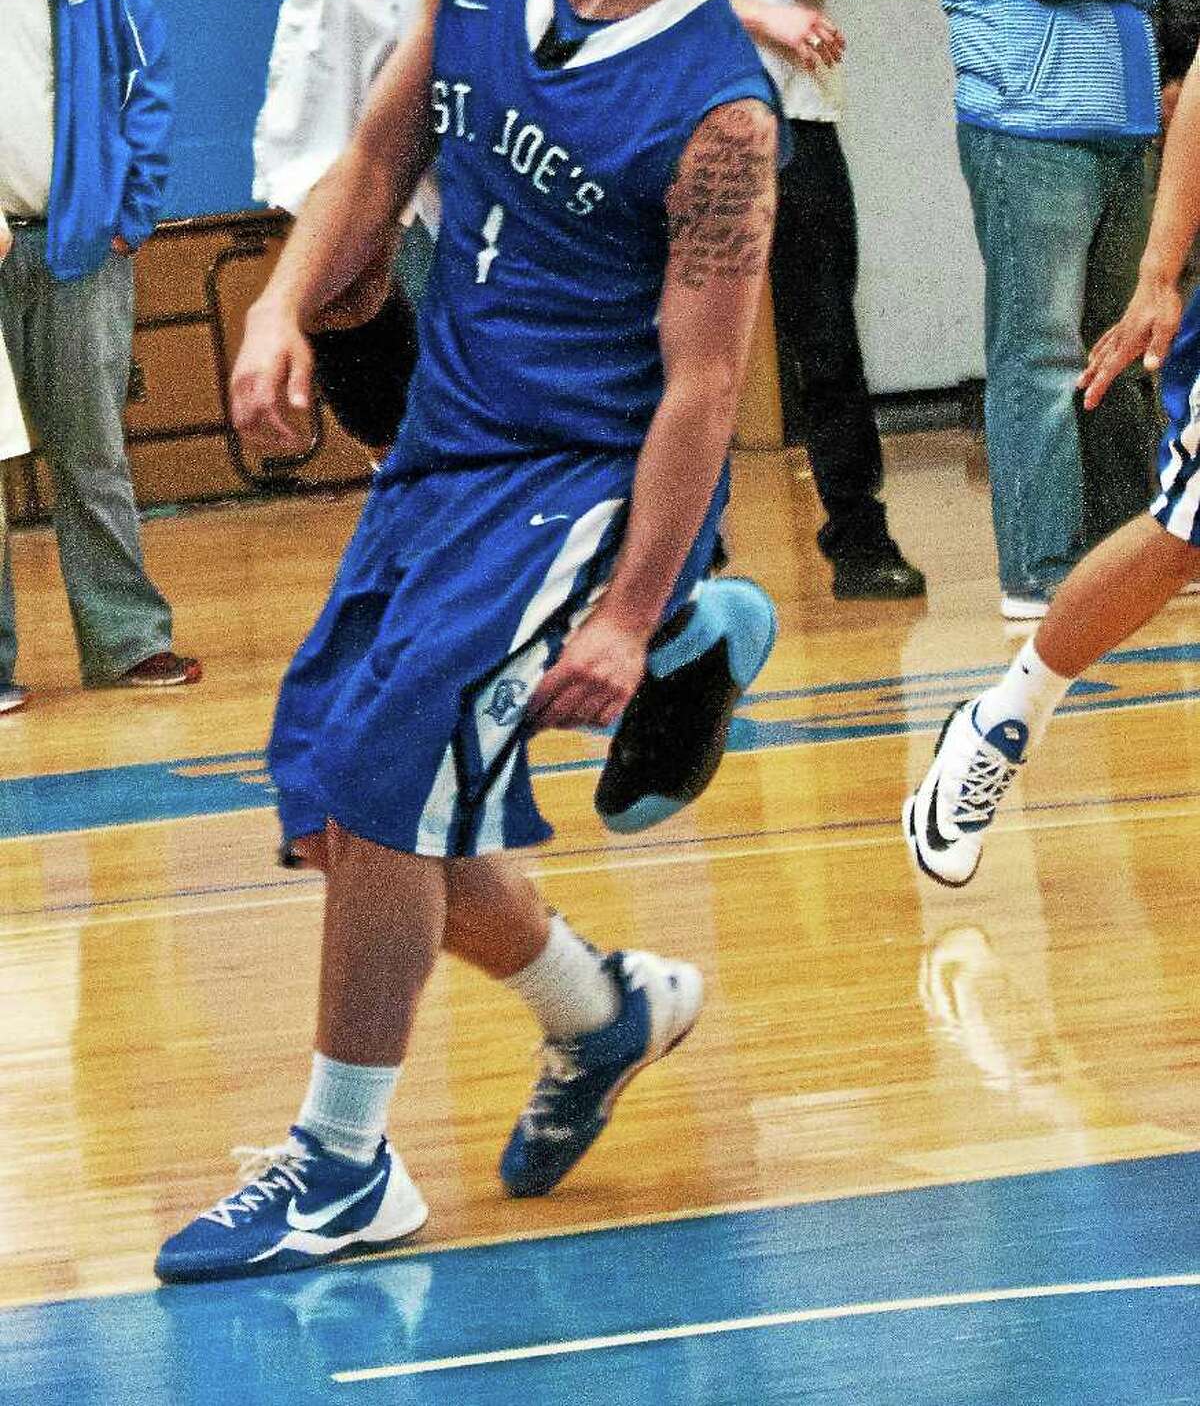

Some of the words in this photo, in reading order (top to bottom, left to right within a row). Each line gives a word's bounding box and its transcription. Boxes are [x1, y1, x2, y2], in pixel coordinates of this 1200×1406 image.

[432, 80, 476, 142] ST.
[492, 108, 605, 216] JOE'S
[474, 204, 504, 284] 1
